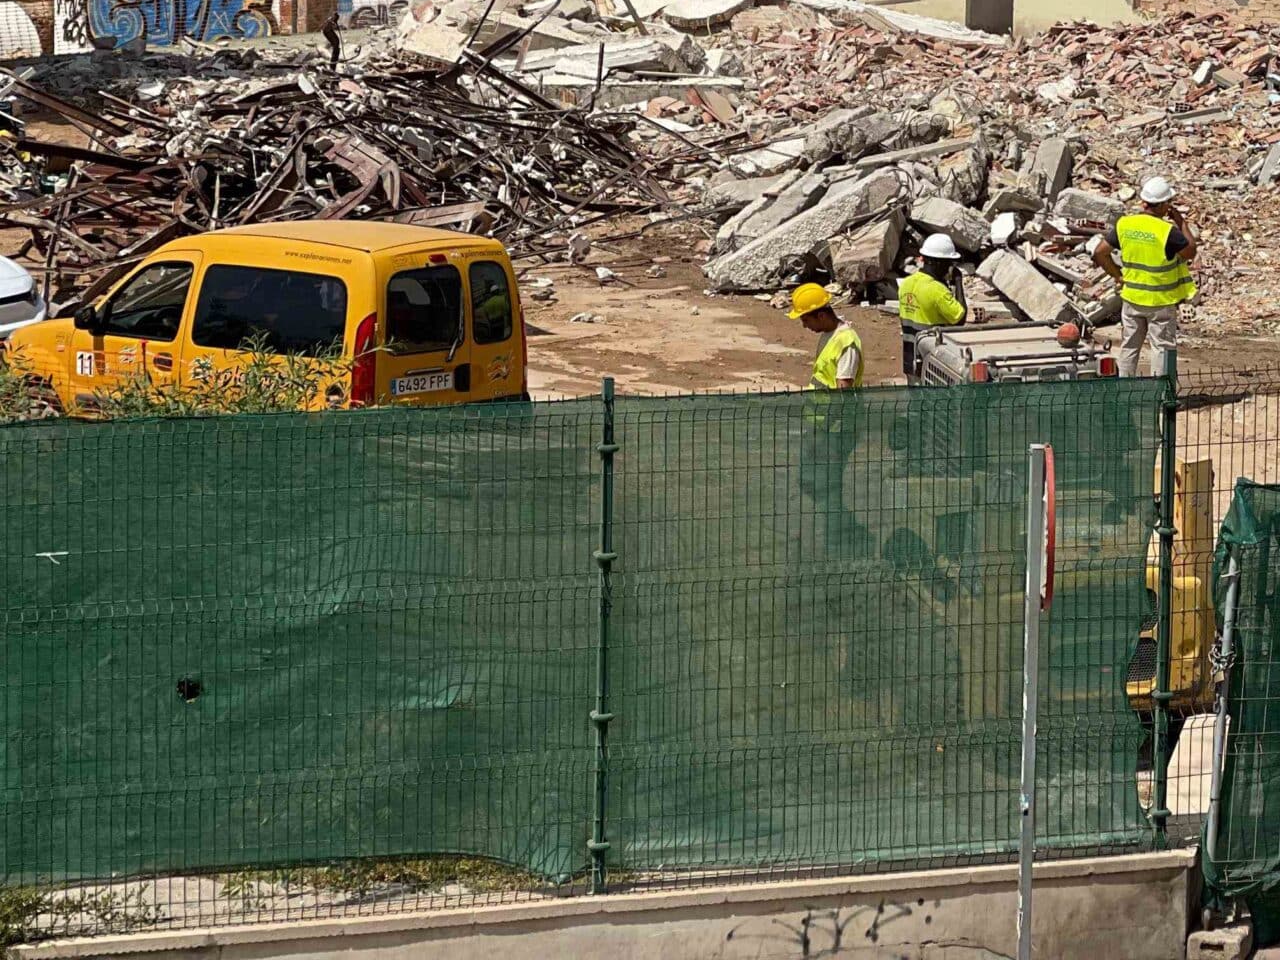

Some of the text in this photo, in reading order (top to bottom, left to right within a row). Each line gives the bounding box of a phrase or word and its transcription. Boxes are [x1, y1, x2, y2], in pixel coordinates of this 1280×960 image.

[77, 354, 93, 376] 11
[398, 373, 450, 393] 6492 FPF
